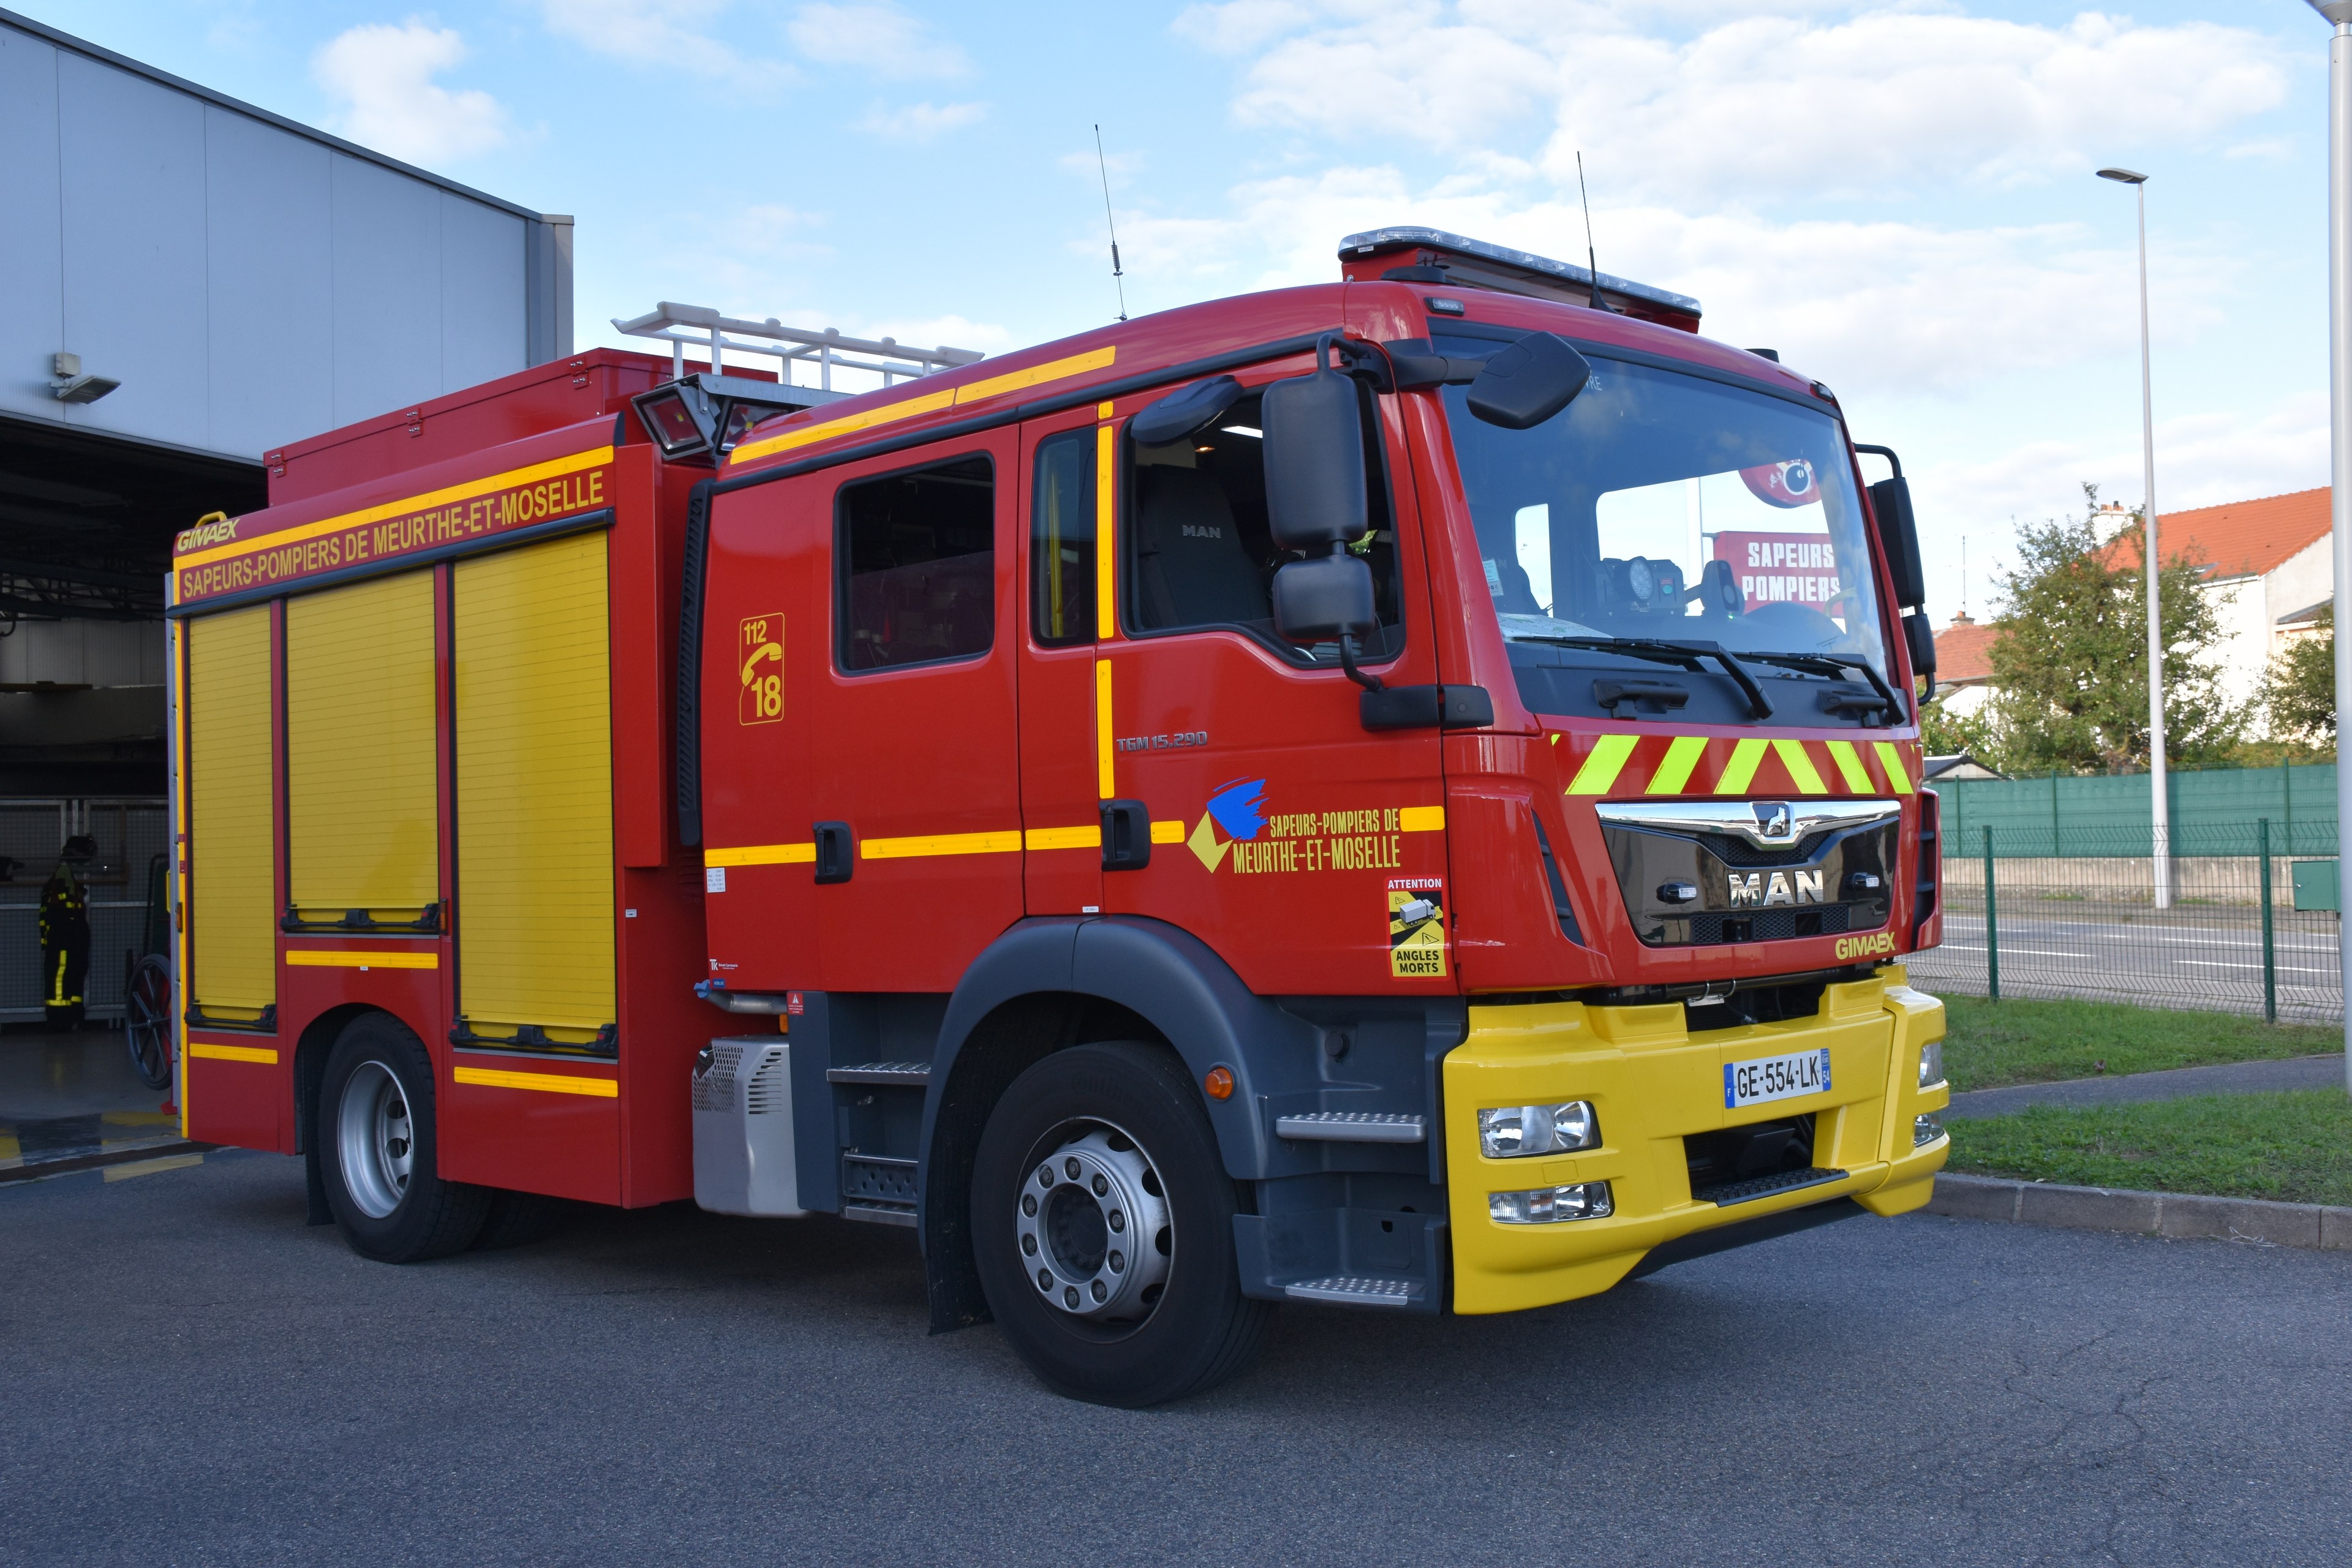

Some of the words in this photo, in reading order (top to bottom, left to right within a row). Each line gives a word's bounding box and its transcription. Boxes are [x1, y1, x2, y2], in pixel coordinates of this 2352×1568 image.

[177, 518, 240, 552] GIMAEX
[184, 537, 340, 598] SAPEURS-POMPIERS
[346, 530, 368, 561] DE
[374, 471, 603, 553] MEURTHE-ET-MOSELLE
[1182, 525, 1221, 538] MAN
[1748, 542, 1834, 568] SAPEURS
[1742, 576, 1841, 602] POMPIERS
[744, 620, 767, 644] 112
[751, 675, 782, 717] 18
[1116, 736, 1150, 752] TGM
[1151, 731, 1208, 749] 15.290
[1270, 809, 1379, 838] SAPEURS-POMPIERS
[1384, 808, 1399, 832] DE
[1233, 835, 1401, 874] MEURTHE-ET-MOSELLE
[1387, 878, 1442, 889] ATTENTION
[1728, 869, 1824, 909] MAN
[1396, 950, 1439, 961] ANGLES
[1835, 932, 1896, 960] GIMAEX
[1399, 962, 1439, 973] MORTS
[1727, 1088, 1731, 1097] F
[1737, 1055, 1820, 1099] GE-554-LK
[1823, 1069, 1830, 1084] 54
